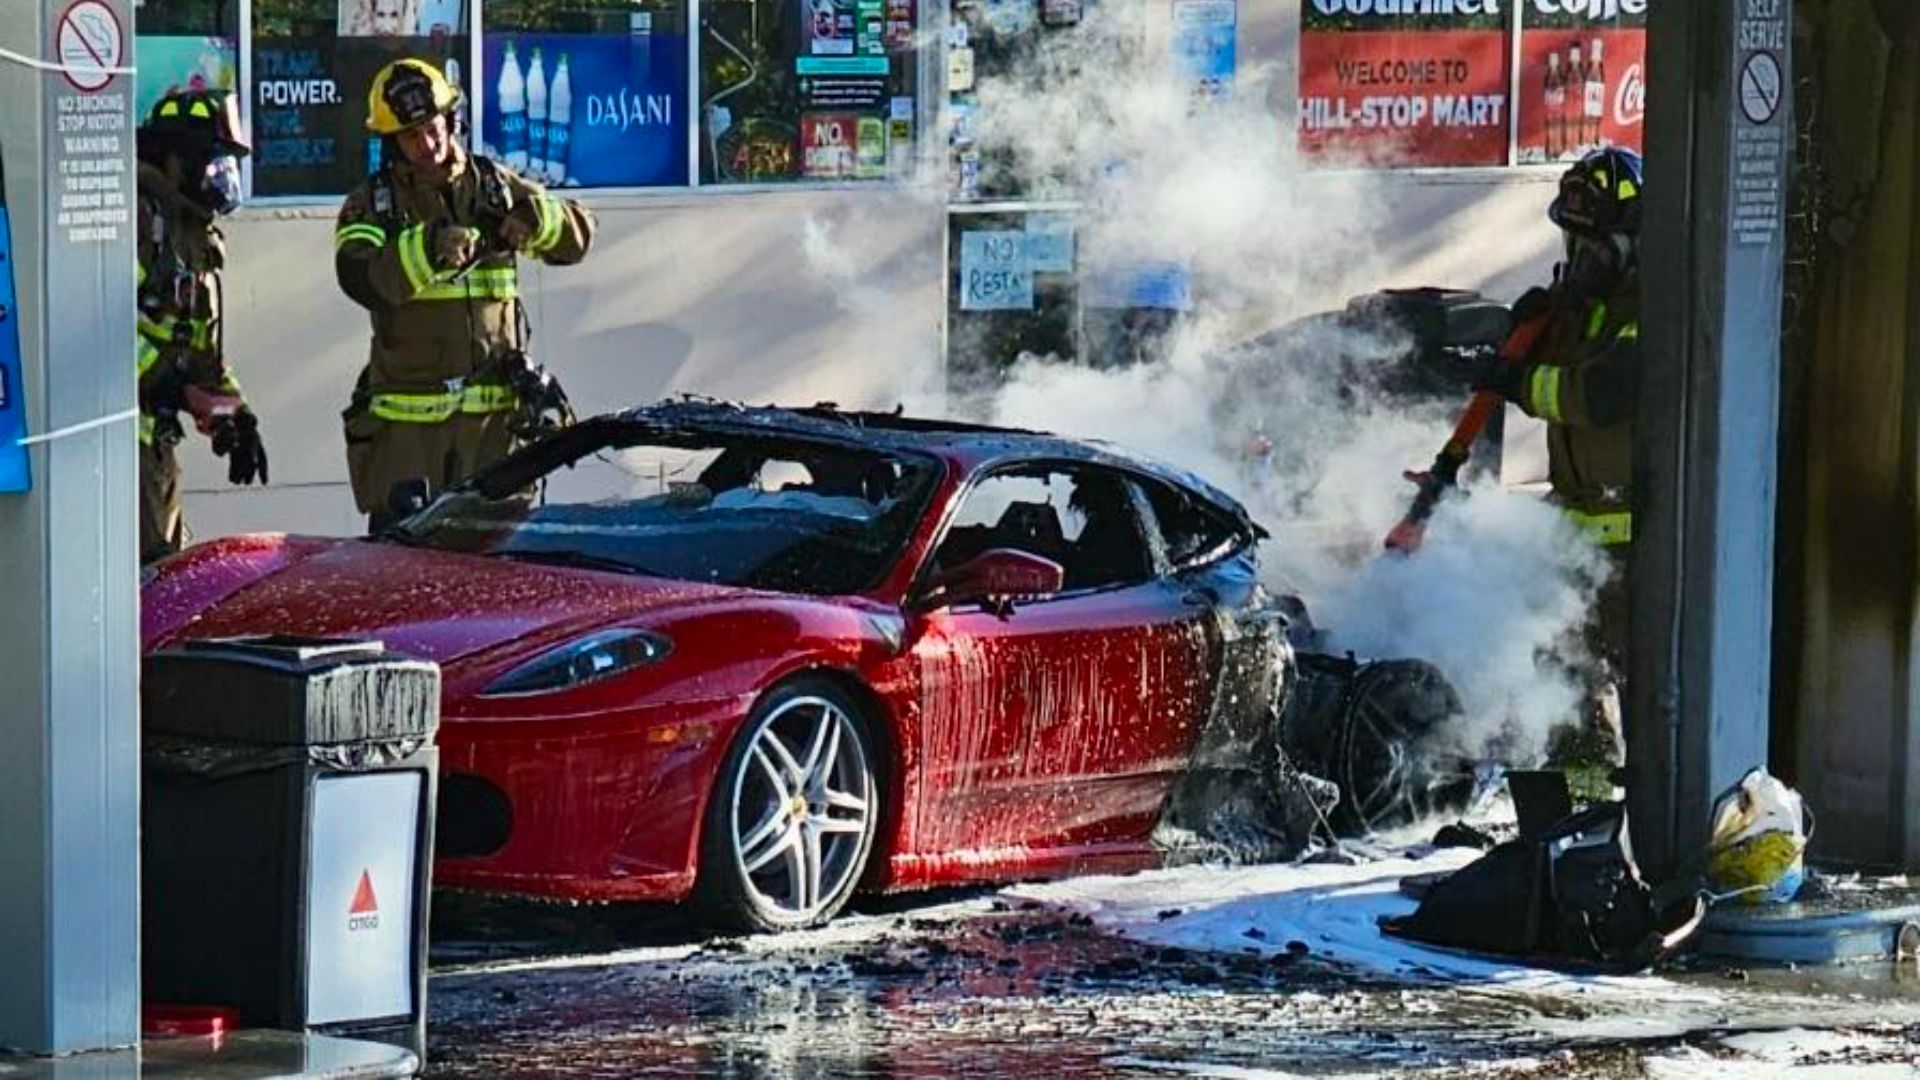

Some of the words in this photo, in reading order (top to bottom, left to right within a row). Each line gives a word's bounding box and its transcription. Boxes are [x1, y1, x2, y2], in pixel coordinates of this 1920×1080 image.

[1740, 20, 1784, 49] SERVE
[1336, 59, 1436, 86] WELCOME
[1443, 59, 1469, 85] TO
[260, 79, 342, 106] POWER.
[57, 114, 85, 131] STOP
[587, 87, 672, 132] DASANI
[1298, 95, 1427, 129] HILL-STOP
[1432, 93, 1504, 127] MART
[815, 121, 842, 145] NO
[982, 238, 1015, 260] NO
